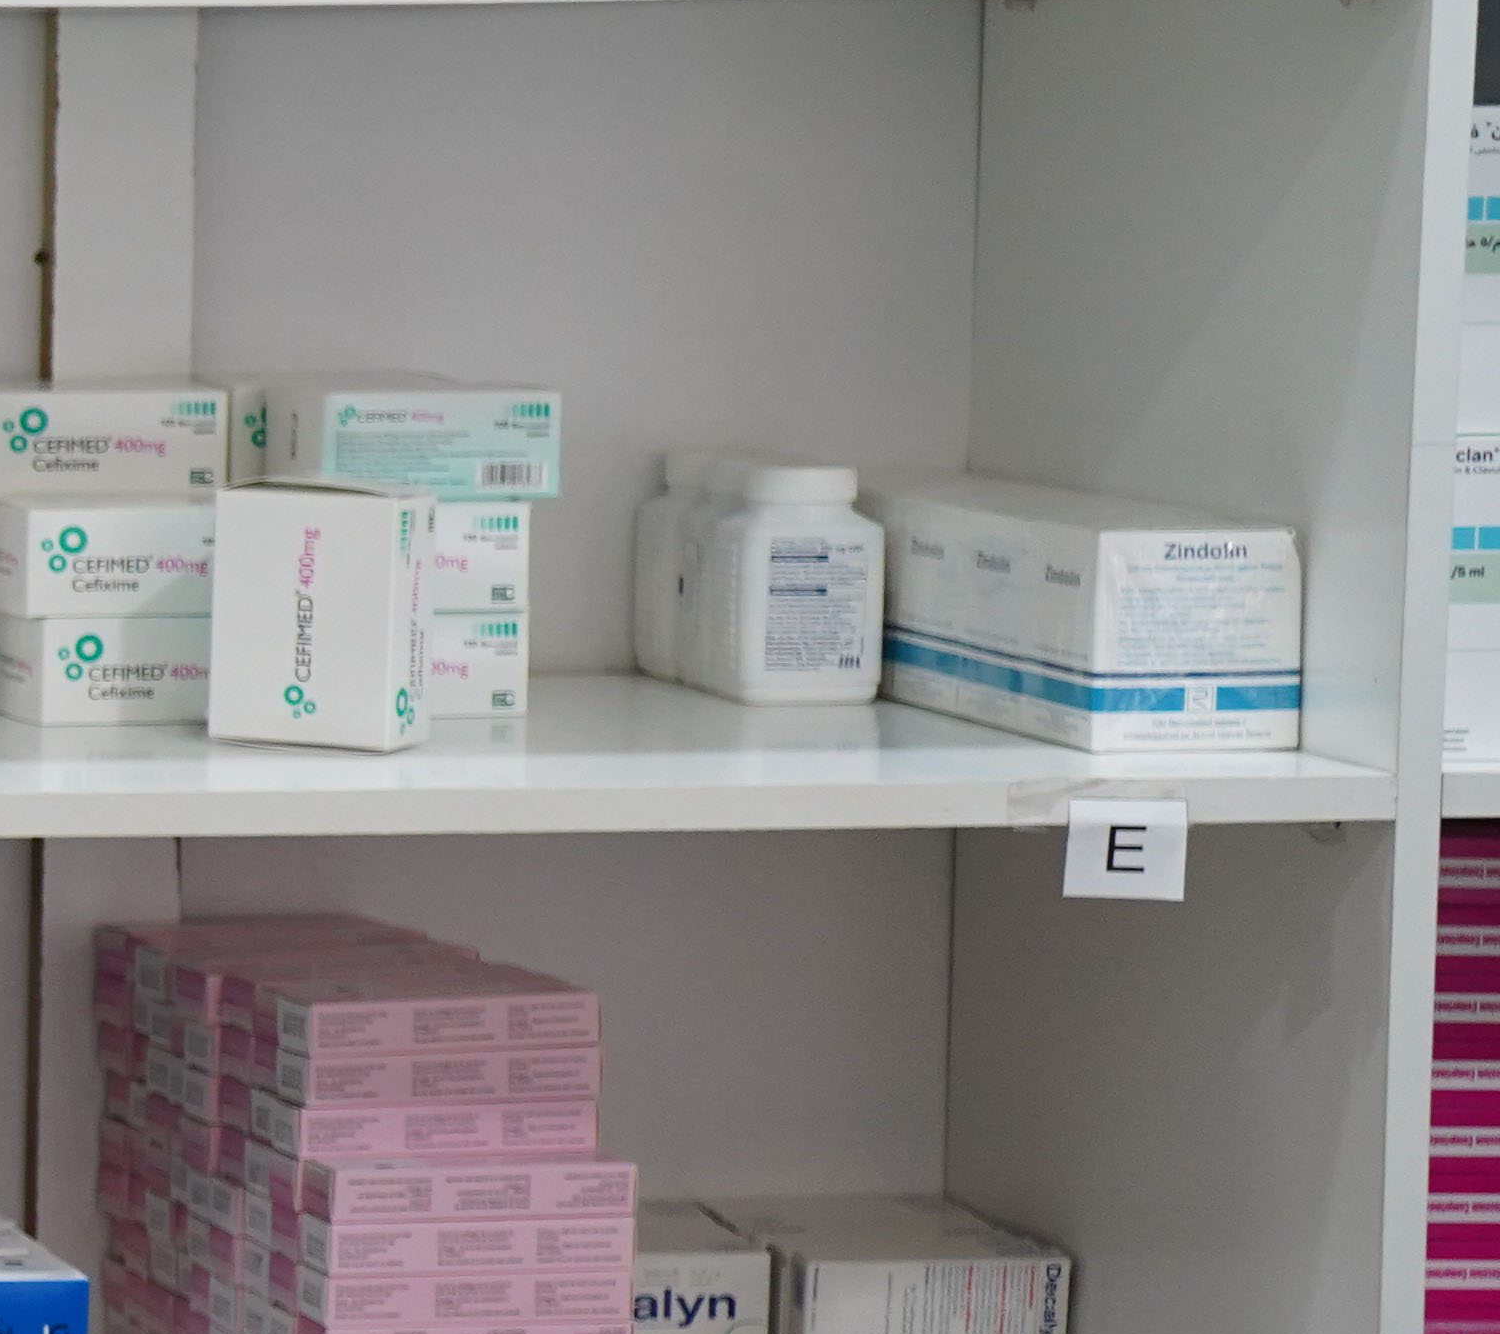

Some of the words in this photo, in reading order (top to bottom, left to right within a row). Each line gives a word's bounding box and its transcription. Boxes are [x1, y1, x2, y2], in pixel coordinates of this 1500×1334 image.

[114, 439, 167, 457] 400mg
[1163, 541, 1248, 561] Zindolin
[72, 579, 139, 593] Cefixime
[88, 686, 155, 700] Cefixime
[1105, 825, 1148, 873] E
[634, 1285, 738, 1329] alyn
